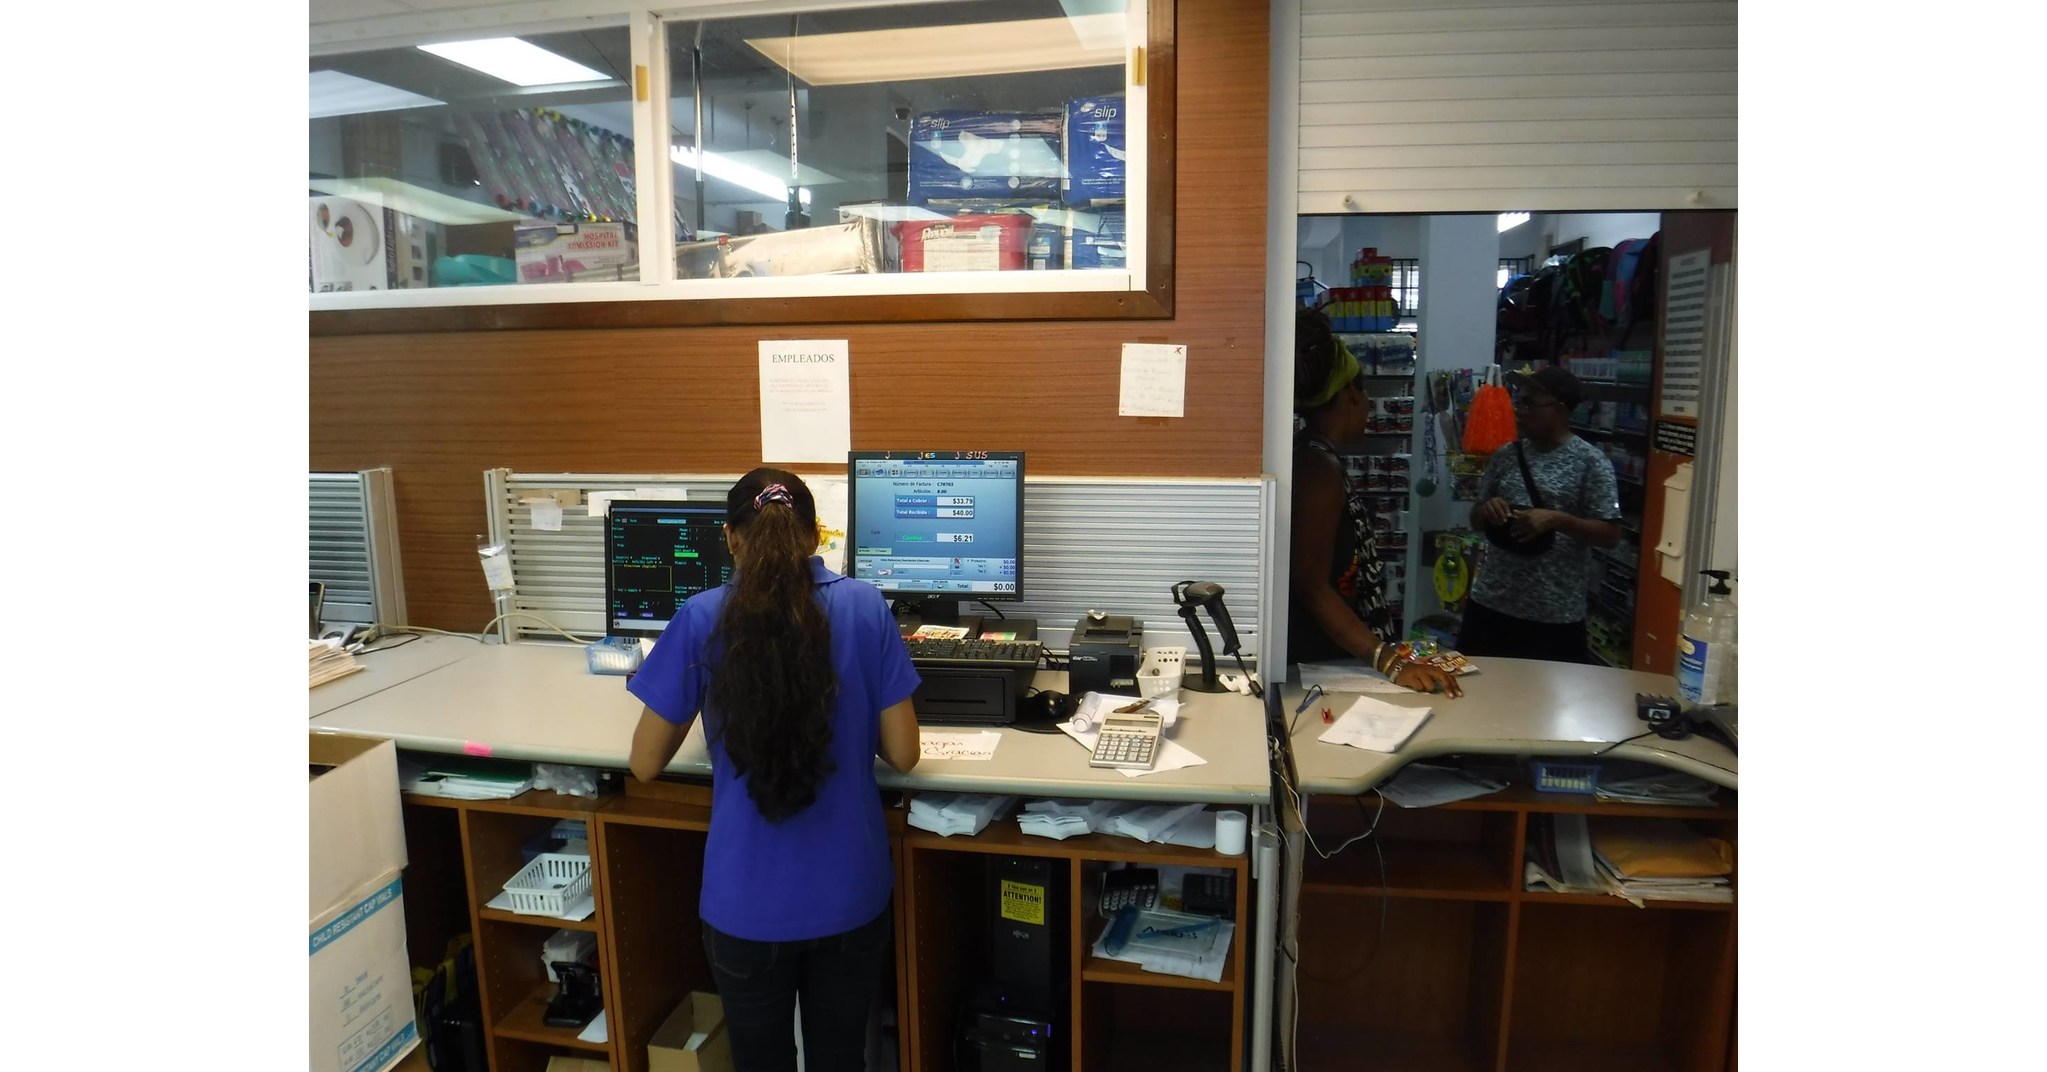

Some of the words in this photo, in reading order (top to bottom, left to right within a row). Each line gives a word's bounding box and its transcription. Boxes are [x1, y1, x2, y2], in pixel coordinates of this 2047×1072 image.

[1094, 105, 1117, 121] slip
[930, 118, 950, 129] slip
[584, 231, 618, 240] HOSPITAL
[568, 241, 605, 250] ADMISSION
[607, 240, 618, 248] KIT
[772, 353, 835, 363] EMPLEADOS
[993, 583, 1015, 591] $0.00
[1003, 890, 1042, 904] ATTENTION!
[312, 929, 332, 947] CHILD
[332, 907, 363, 937] RESISTANT
